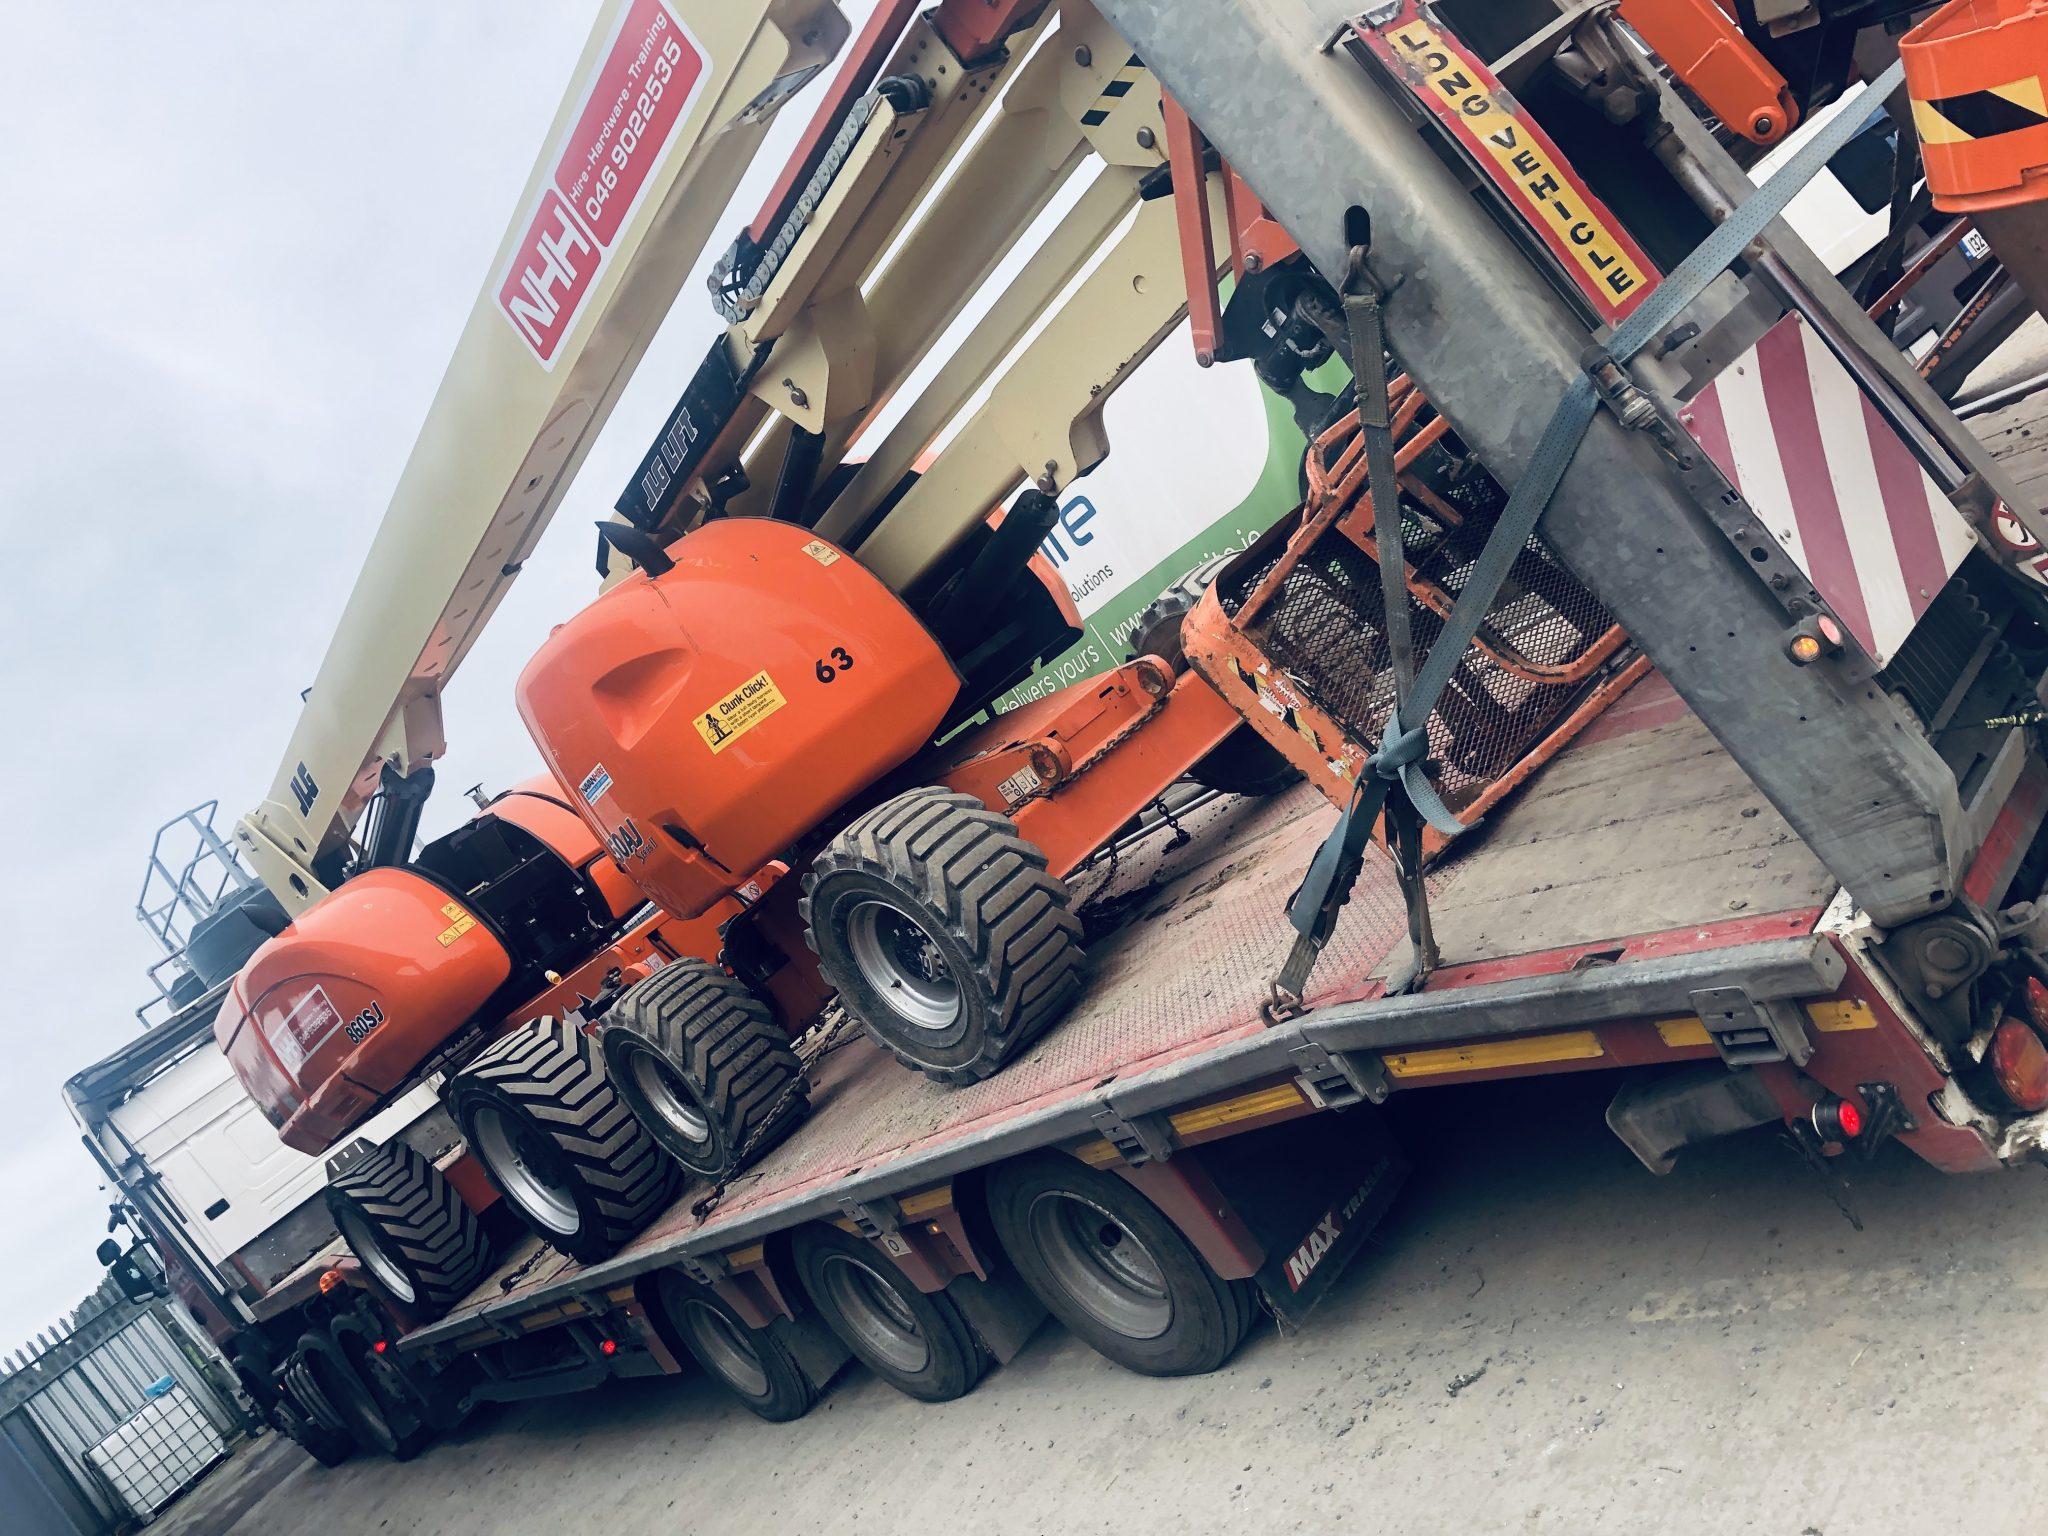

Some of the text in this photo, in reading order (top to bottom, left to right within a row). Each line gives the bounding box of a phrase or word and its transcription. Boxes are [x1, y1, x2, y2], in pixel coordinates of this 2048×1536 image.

[569, 11, 667, 204] Hire Hardware Training
[585, 36, 682, 221] 046 9022535
[1399, 34, 1635, 295] LONG VEHICLE
[508, 204, 590, 347] NHH
[641, 407, 697, 511] JLG LIFT
[1072, 564, 1114, 603] olutions
[719, 675, 769, 715] Clunk Click!
[816, 647, 854, 684] 63
[1055, 643, 1100, 688] yours
[290, 760, 320, 818] JLG
[345, 1000, 385, 1045] 860SJ
[1288, 1211, 1340, 1286] MAX
